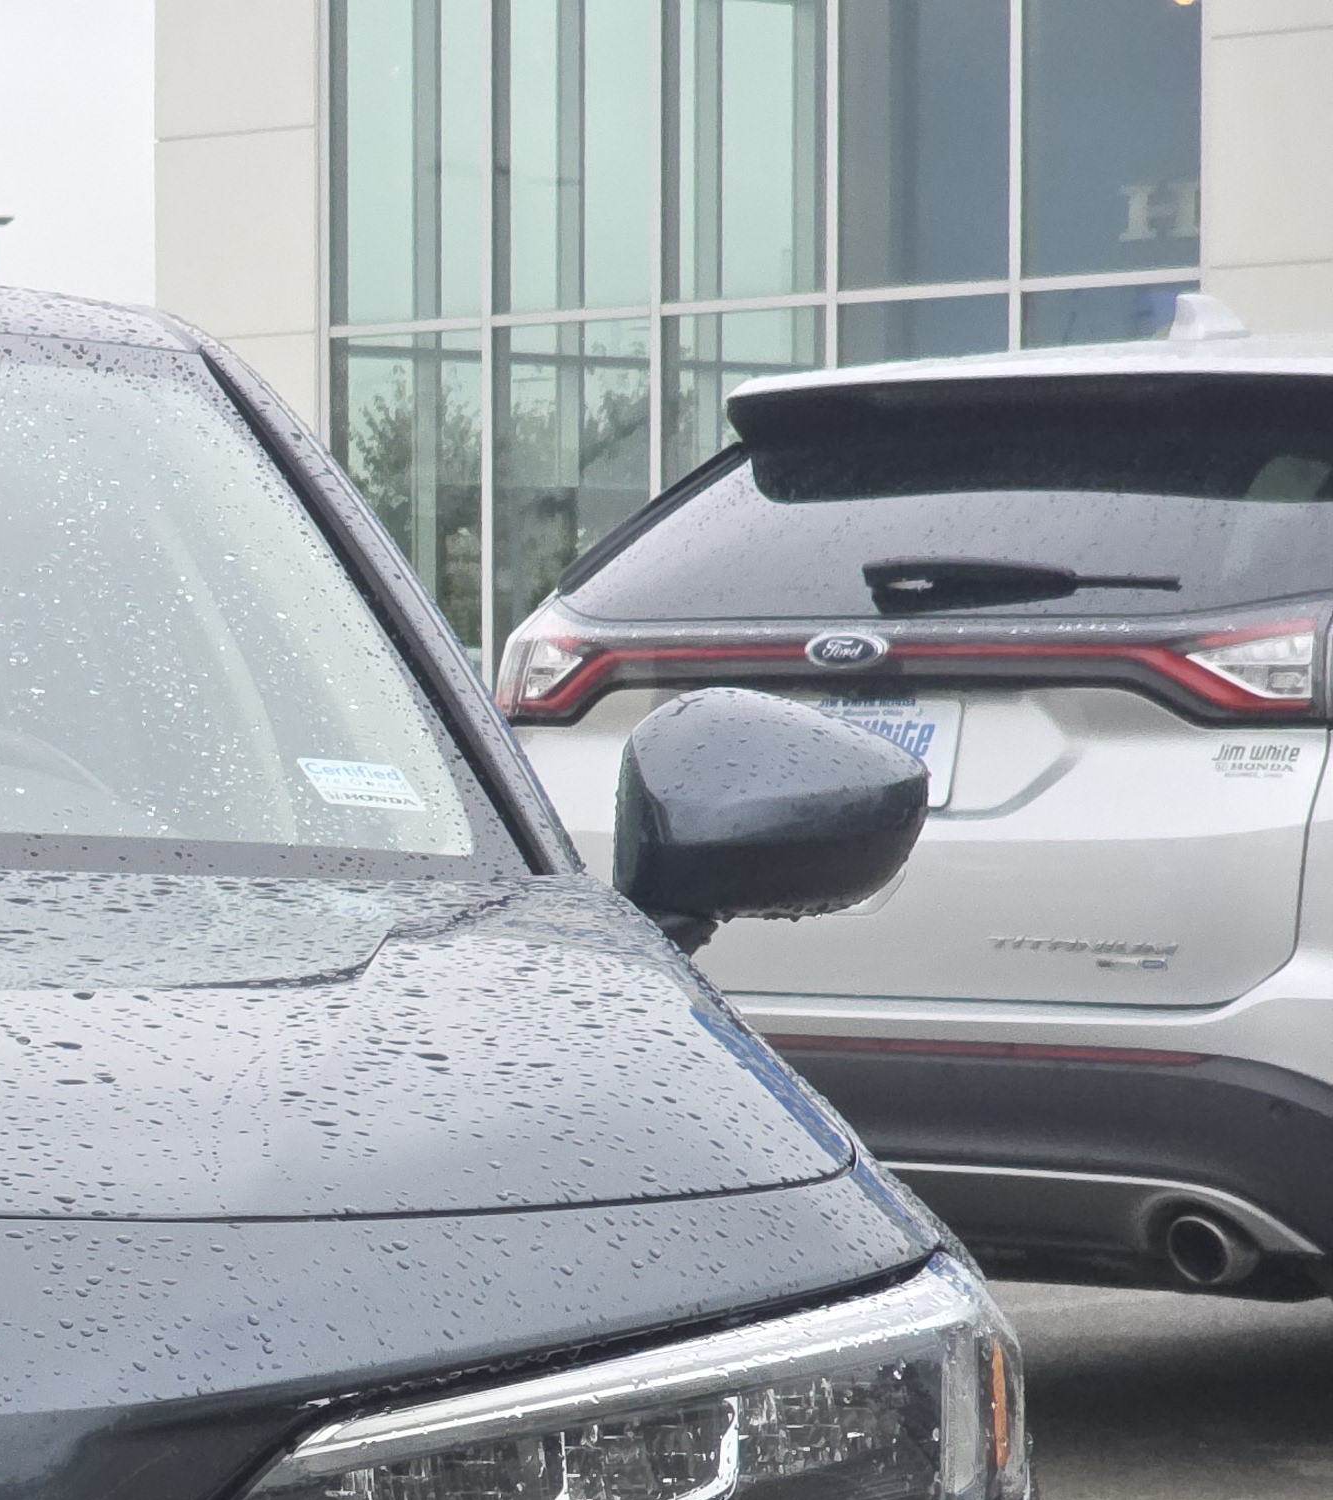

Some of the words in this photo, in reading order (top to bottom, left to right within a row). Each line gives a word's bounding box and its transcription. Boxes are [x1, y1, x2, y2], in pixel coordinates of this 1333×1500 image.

[822, 640, 864, 659] Ford
[1212, 745, 1245, 761] Jim
[304, 763, 401, 781] Certified
[1230, 763, 1294, 772] HONDA
[342, 793, 419, 806] HONDA
